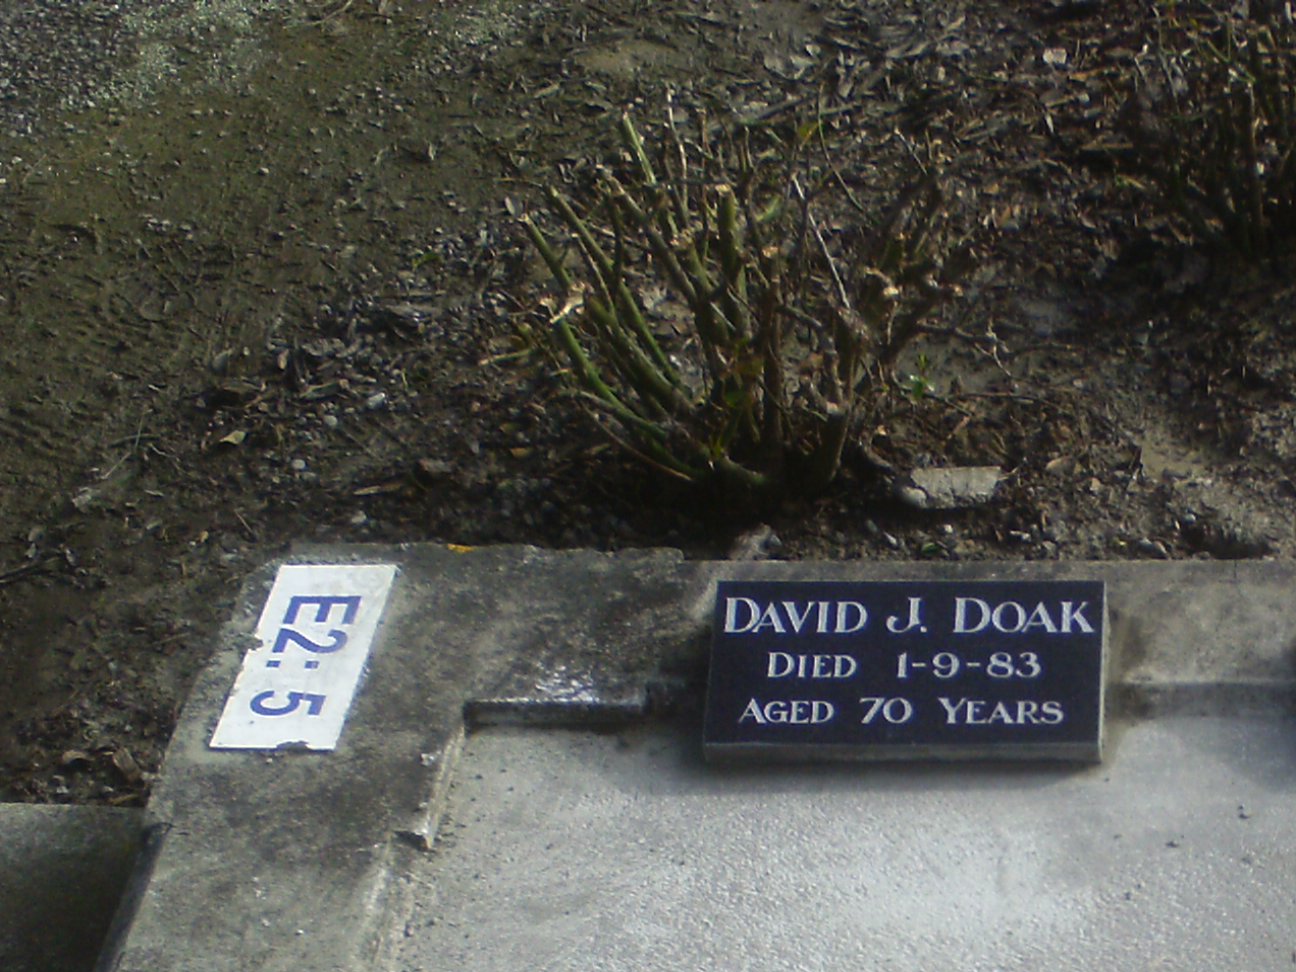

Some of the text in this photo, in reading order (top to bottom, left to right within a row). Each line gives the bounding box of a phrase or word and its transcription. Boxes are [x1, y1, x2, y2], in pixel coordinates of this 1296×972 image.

[724, 597, 1095, 633] DAVID J. DOAK
[768, 652, 1042, 678] DIED 1-9-83
[738, 697, 1065, 724] AGED 70 YEARS
